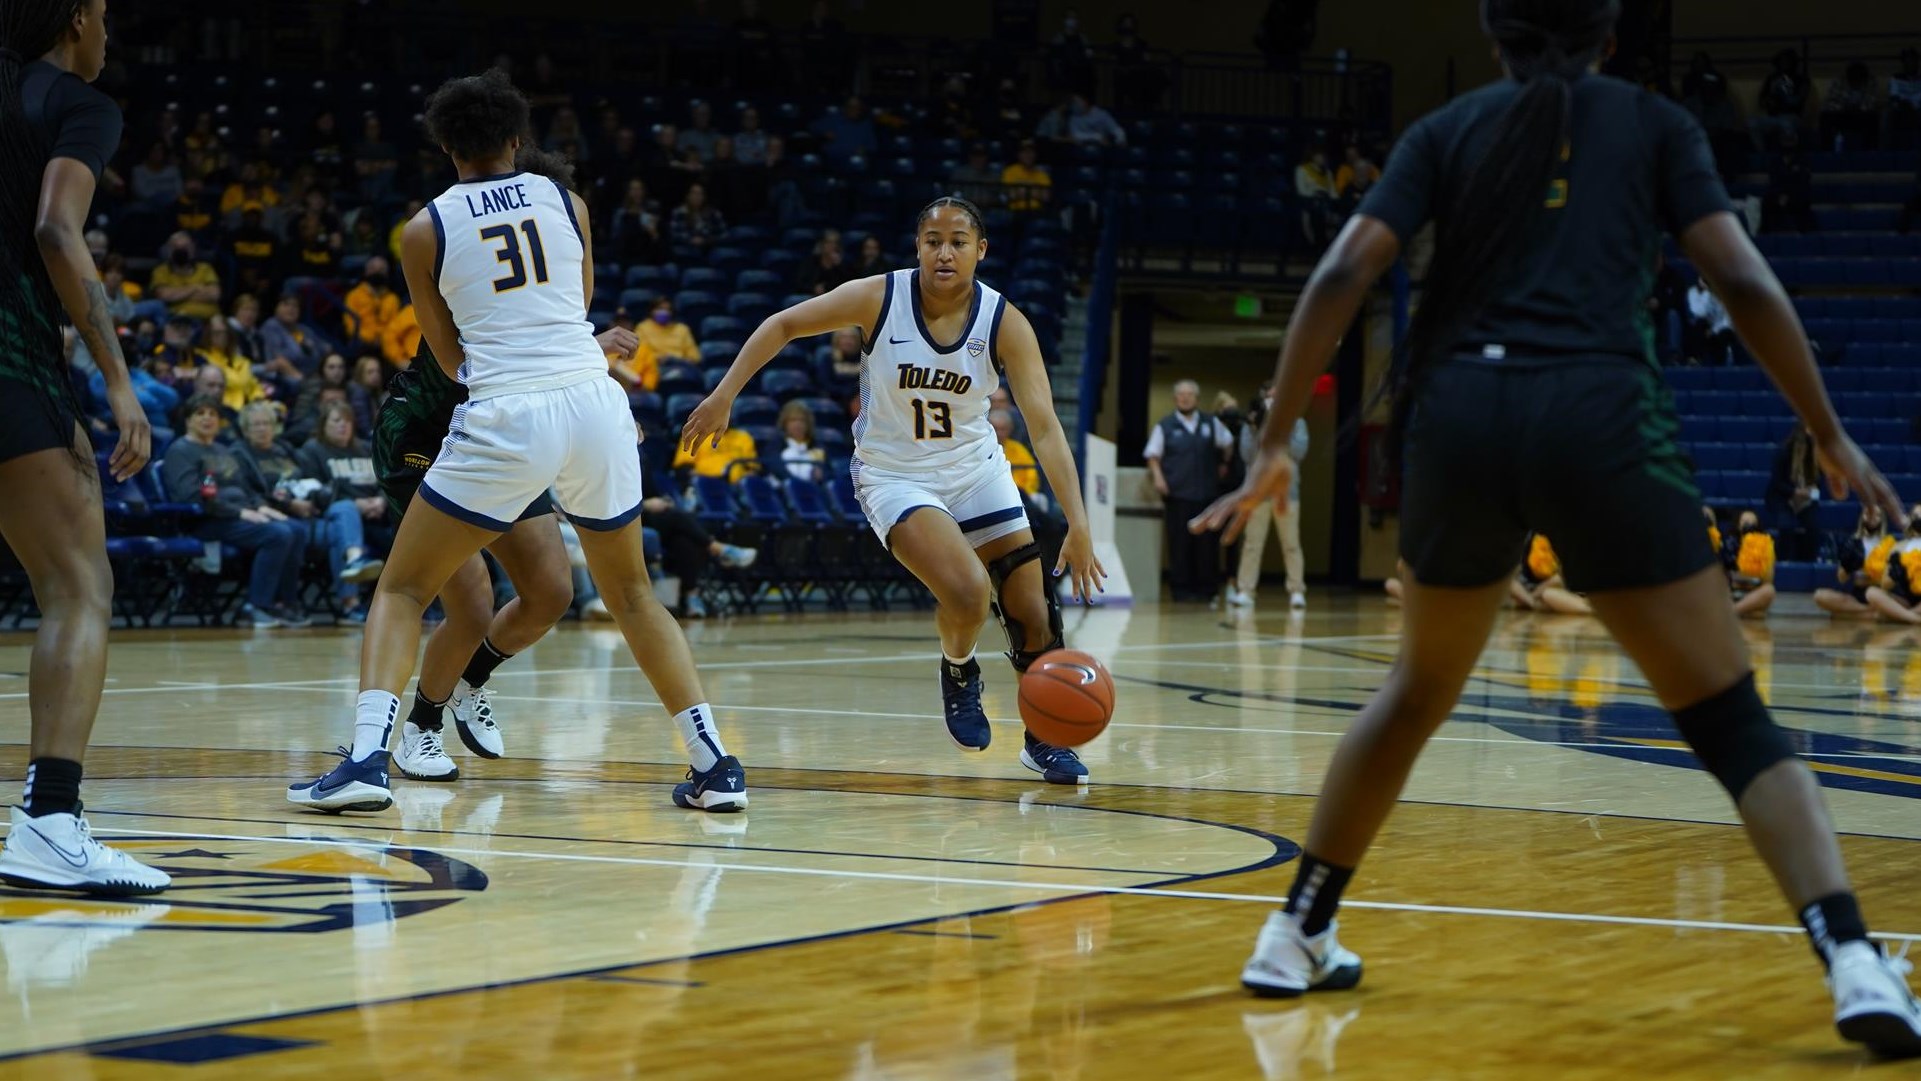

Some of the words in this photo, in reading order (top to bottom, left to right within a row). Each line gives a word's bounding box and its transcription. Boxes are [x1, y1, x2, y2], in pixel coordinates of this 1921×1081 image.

[466, 184, 531, 218] LANCE
[478, 217, 549, 294] 31
[898, 363, 972, 394] TOLEDO
[911, 398, 953, 440] 13
